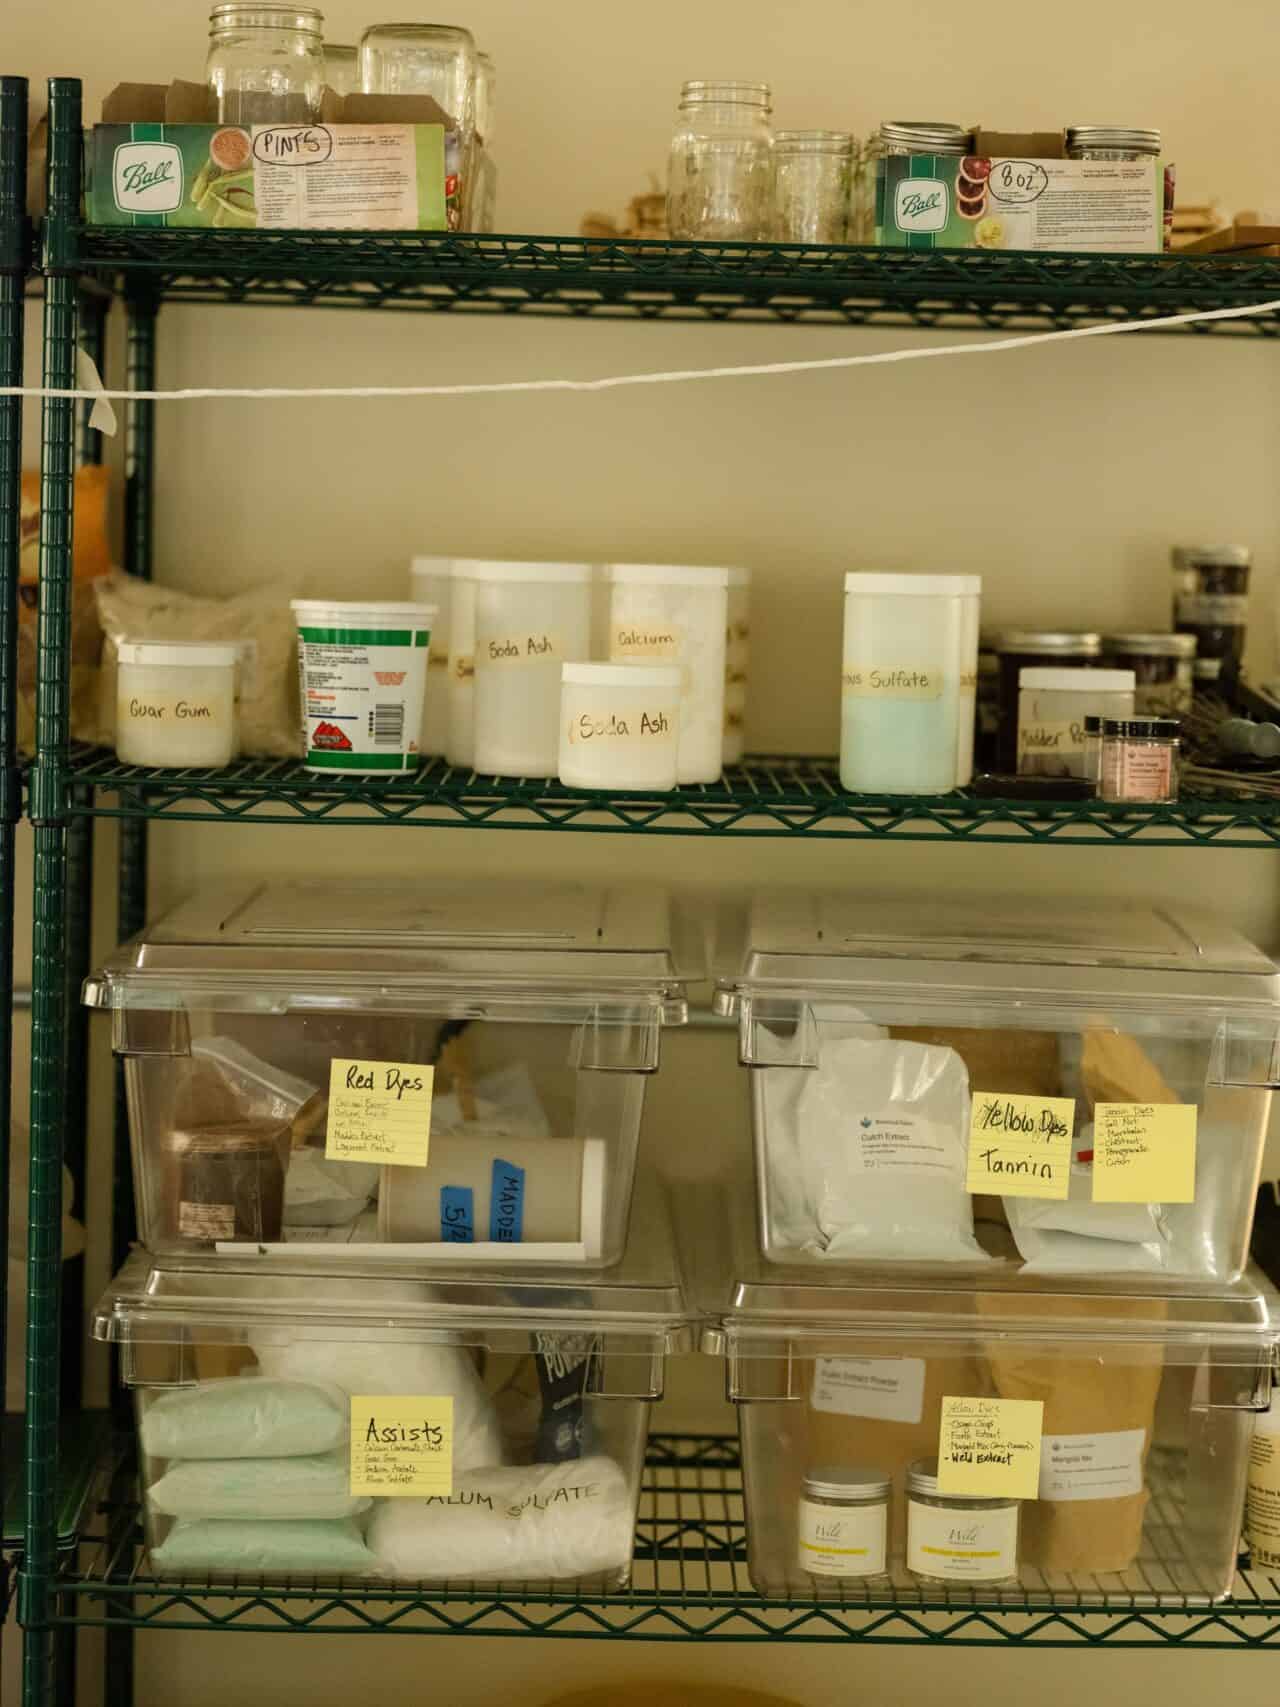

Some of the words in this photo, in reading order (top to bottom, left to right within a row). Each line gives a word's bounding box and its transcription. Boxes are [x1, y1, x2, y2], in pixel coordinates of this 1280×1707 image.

[263, 131, 321, 157] PINTS
[123, 161, 174, 193] Ball
[1001, 165, 1013, 187] 8
[902, 192, 942, 218] Ball
[488, 640, 519, 659] Soda
[527, 636, 553, 654] Ash
[618, 631, 674, 646] Calcium
[869, 670, 929, 690] Sulfate
[130, 700, 165, 718] Guar
[175, 701, 211, 719] Gum
[580, 714, 629, 739] Soda
[640, 712, 669, 735] Ash
[346, 1065, 374, 1091] Red
[385, 1068, 423, 1101] Dyes
[982, 1100, 1034, 1135] Yellow
[1039, 1110, 1068, 1144] Dyes
[980, 1148, 1052, 1179] Tannin
[497, 1176, 520, 1241] MADDE
[366, 1417, 442, 1444] Assists
[952, 1452, 972, 1463] Weld
[977, 1452, 1013, 1466] Extract
[426, 1491, 493, 1511] ALUM
